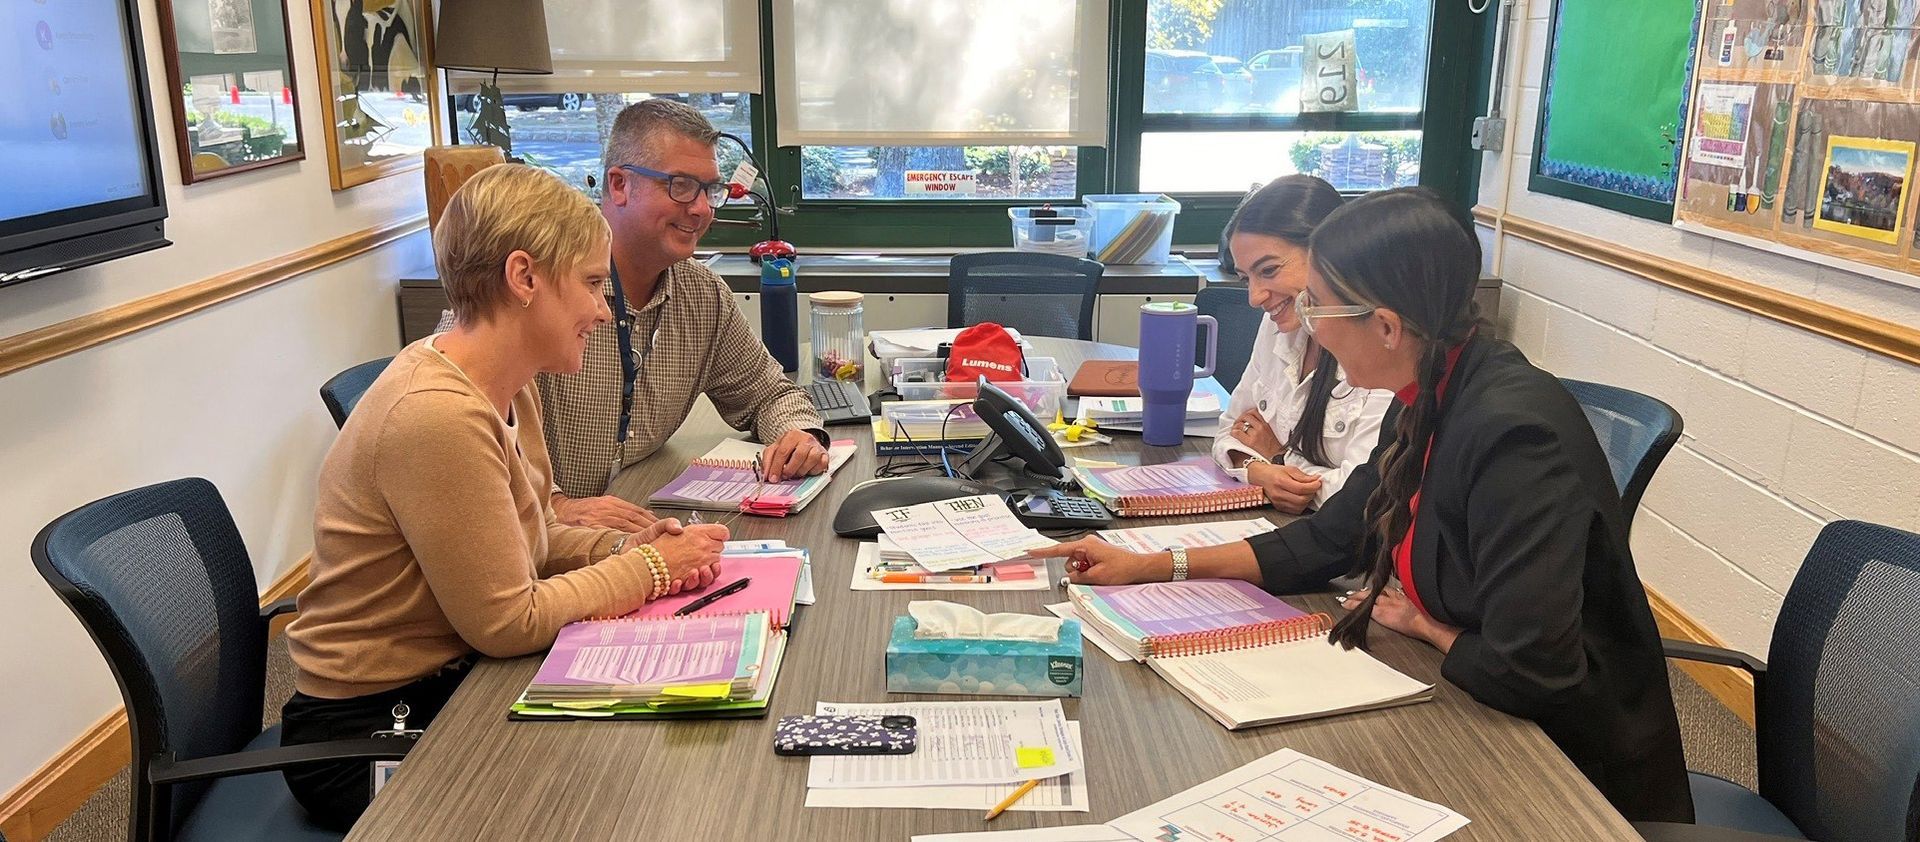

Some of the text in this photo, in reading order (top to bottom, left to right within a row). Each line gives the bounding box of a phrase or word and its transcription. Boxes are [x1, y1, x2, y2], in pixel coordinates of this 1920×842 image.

[907, 173, 946, 182] EMERGENCY
[925, 183, 956, 191] WINDOW
[961, 358, 1013, 372] Lumens
[945, 497, 985, 511] THEN
[886, 507, 911, 521] IF
